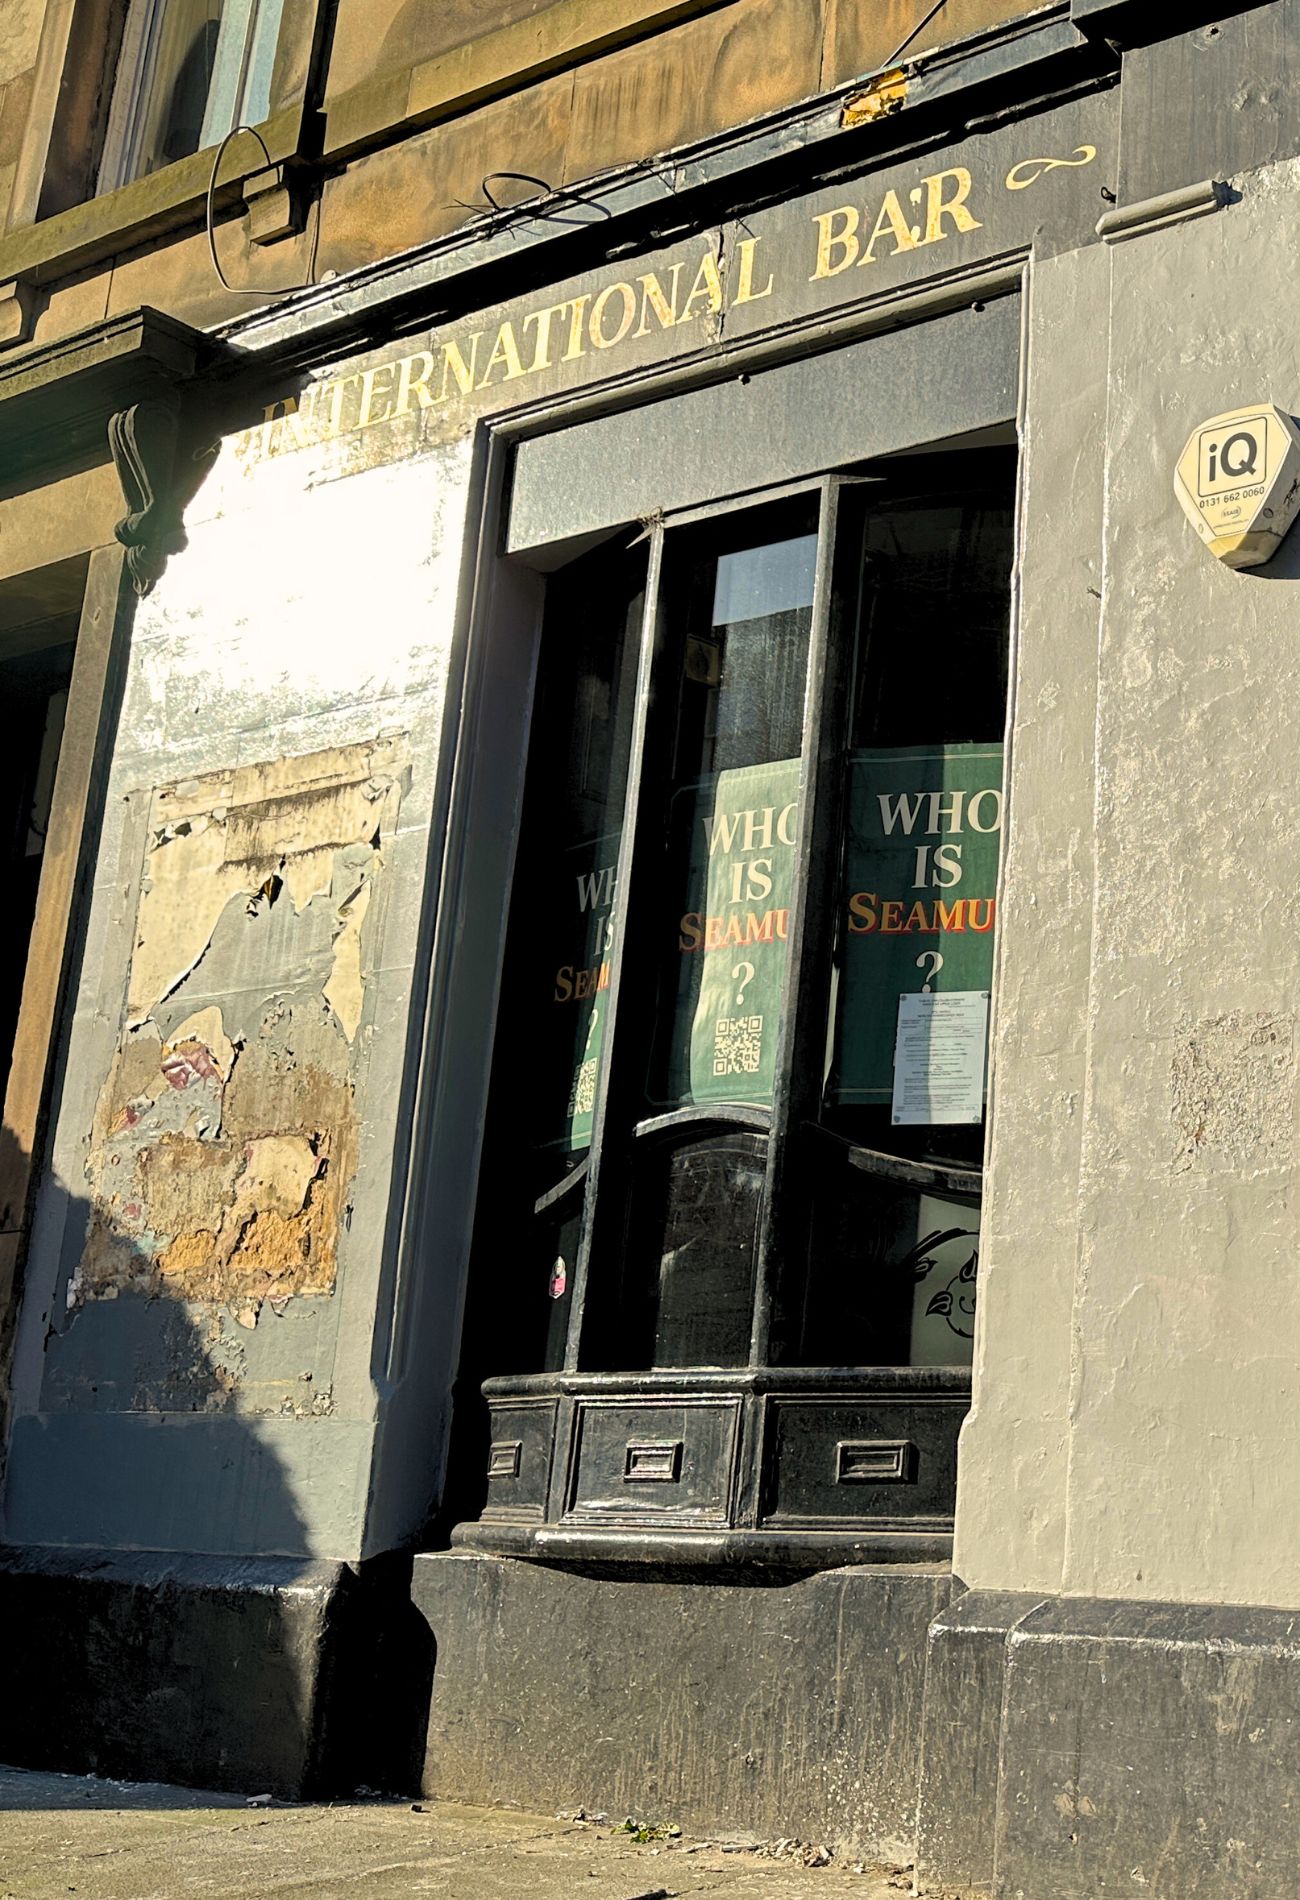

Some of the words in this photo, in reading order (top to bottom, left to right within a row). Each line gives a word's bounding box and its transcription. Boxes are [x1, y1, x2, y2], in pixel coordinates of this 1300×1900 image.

[257, 236, 774, 458] INTERNATIONAL
[809, 167, 984, 283] BAR
[1209, 432, 1257, 482] iQ
[1199, 497, 1220, 508] 0131
[1223, 492, 1240, 503] 662
[1242, 486, 1265, 498] 0060
[702, 803, 798, 856] WHO
[876, 789, 1002, 836] WHO
[728, 859, 773, 904] IS
[911, 844, 963, 889] IS
[732, 962, 755, 1005] ?
[916, 951, 944, 993] ?
